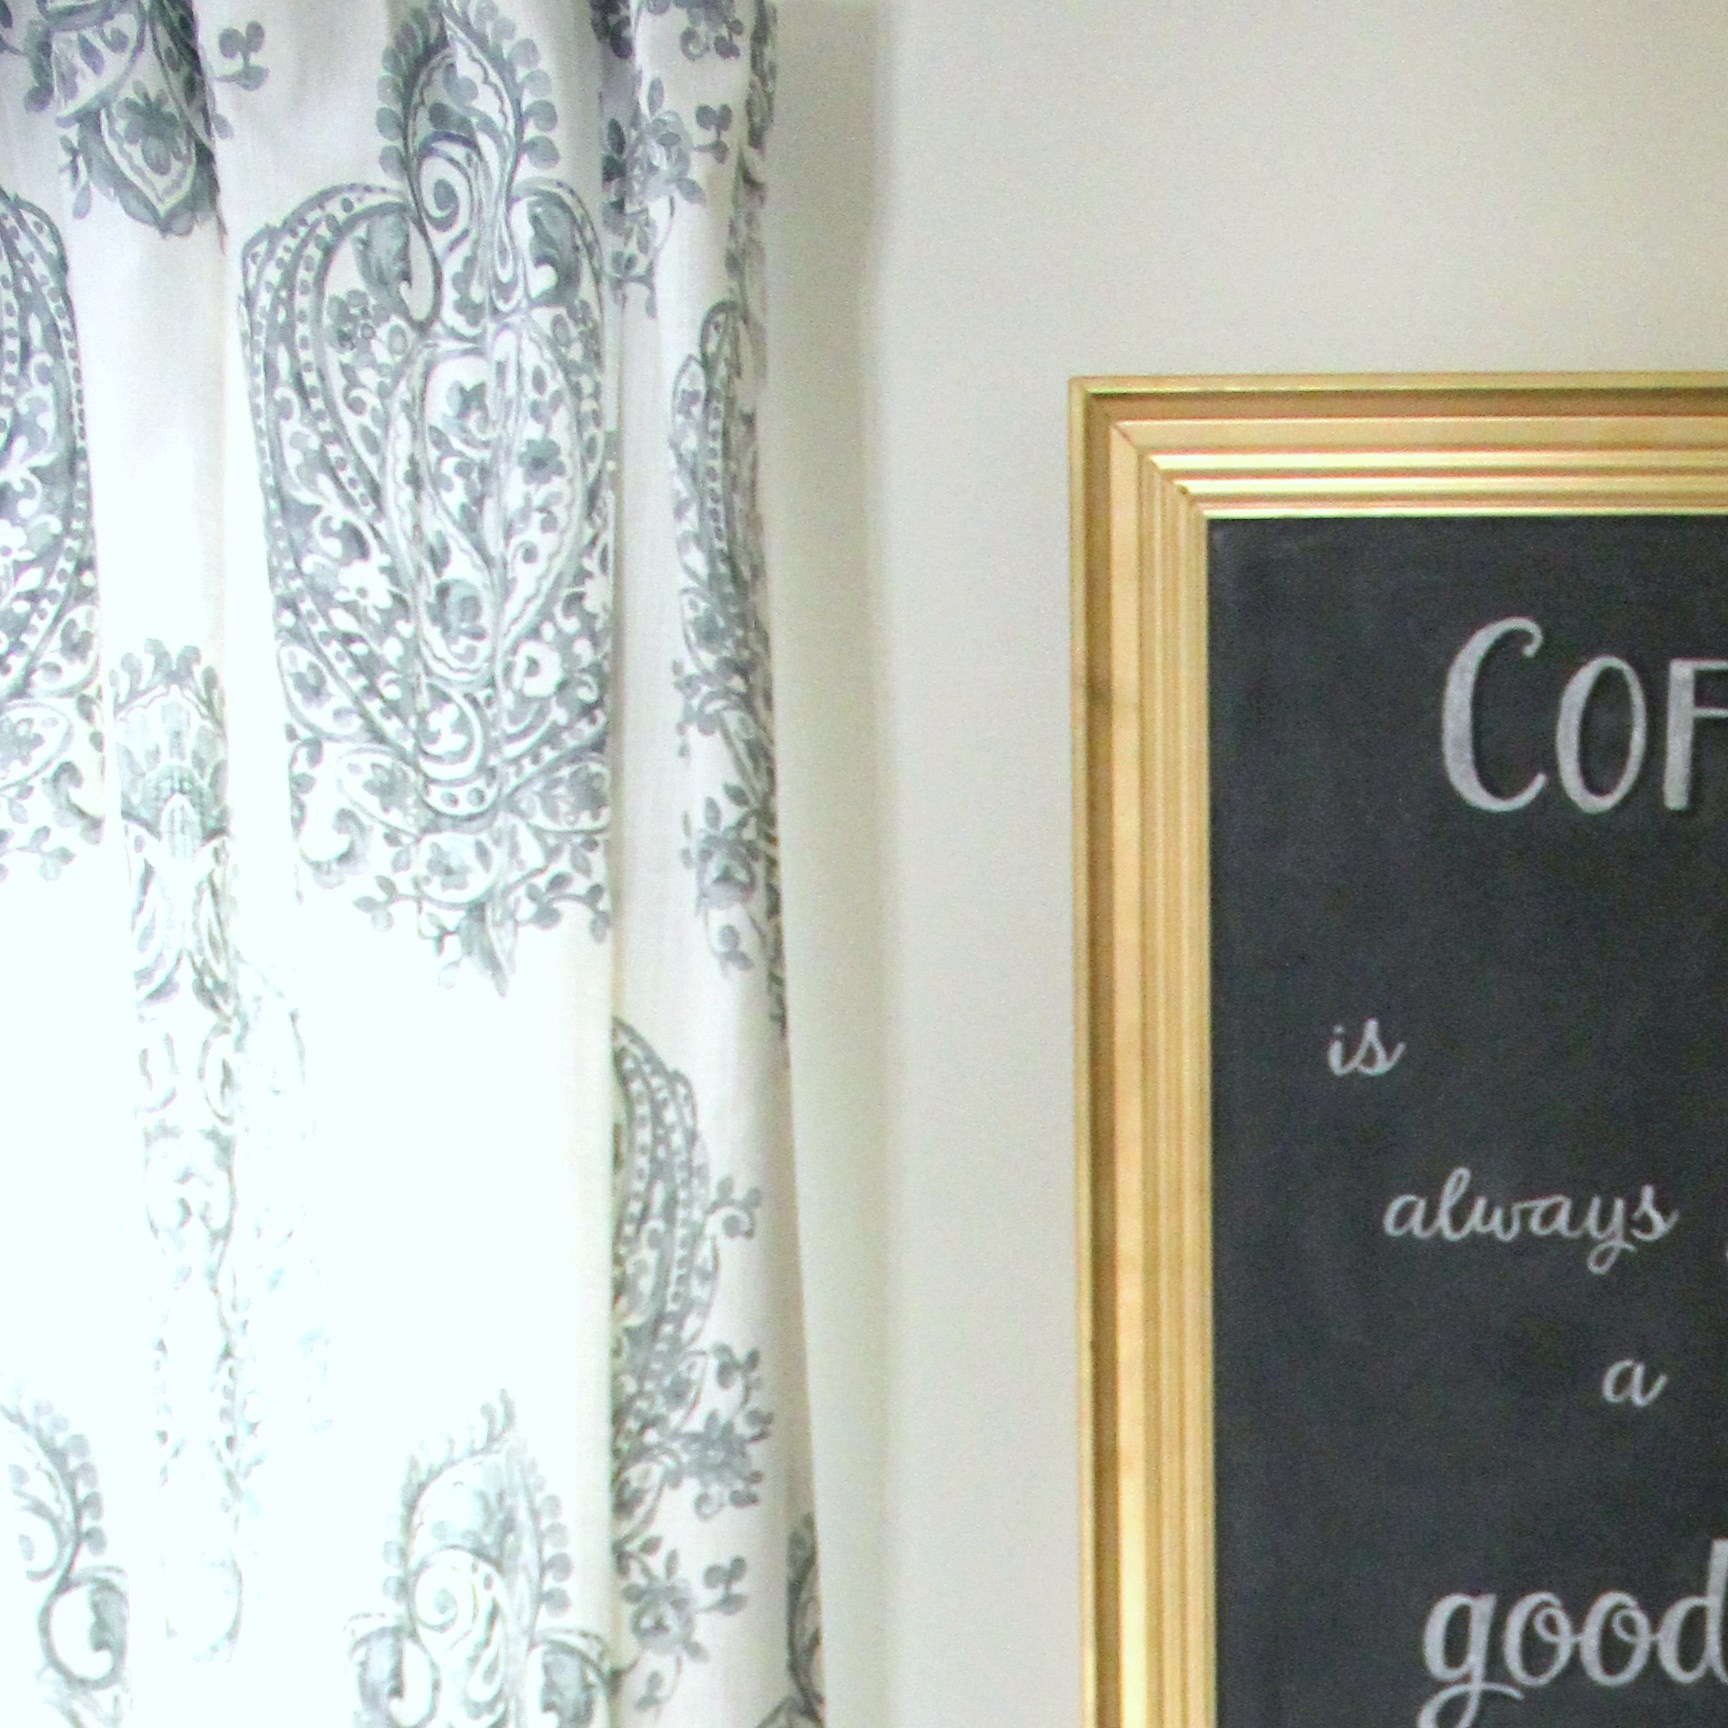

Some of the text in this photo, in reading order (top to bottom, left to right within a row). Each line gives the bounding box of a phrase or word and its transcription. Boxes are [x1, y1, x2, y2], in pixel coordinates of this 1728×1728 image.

[1328, 1018, 1406, 1076] is
[1383, 1167, 1677, 1274] always
[1602, 1357, 1668, 1407] a
